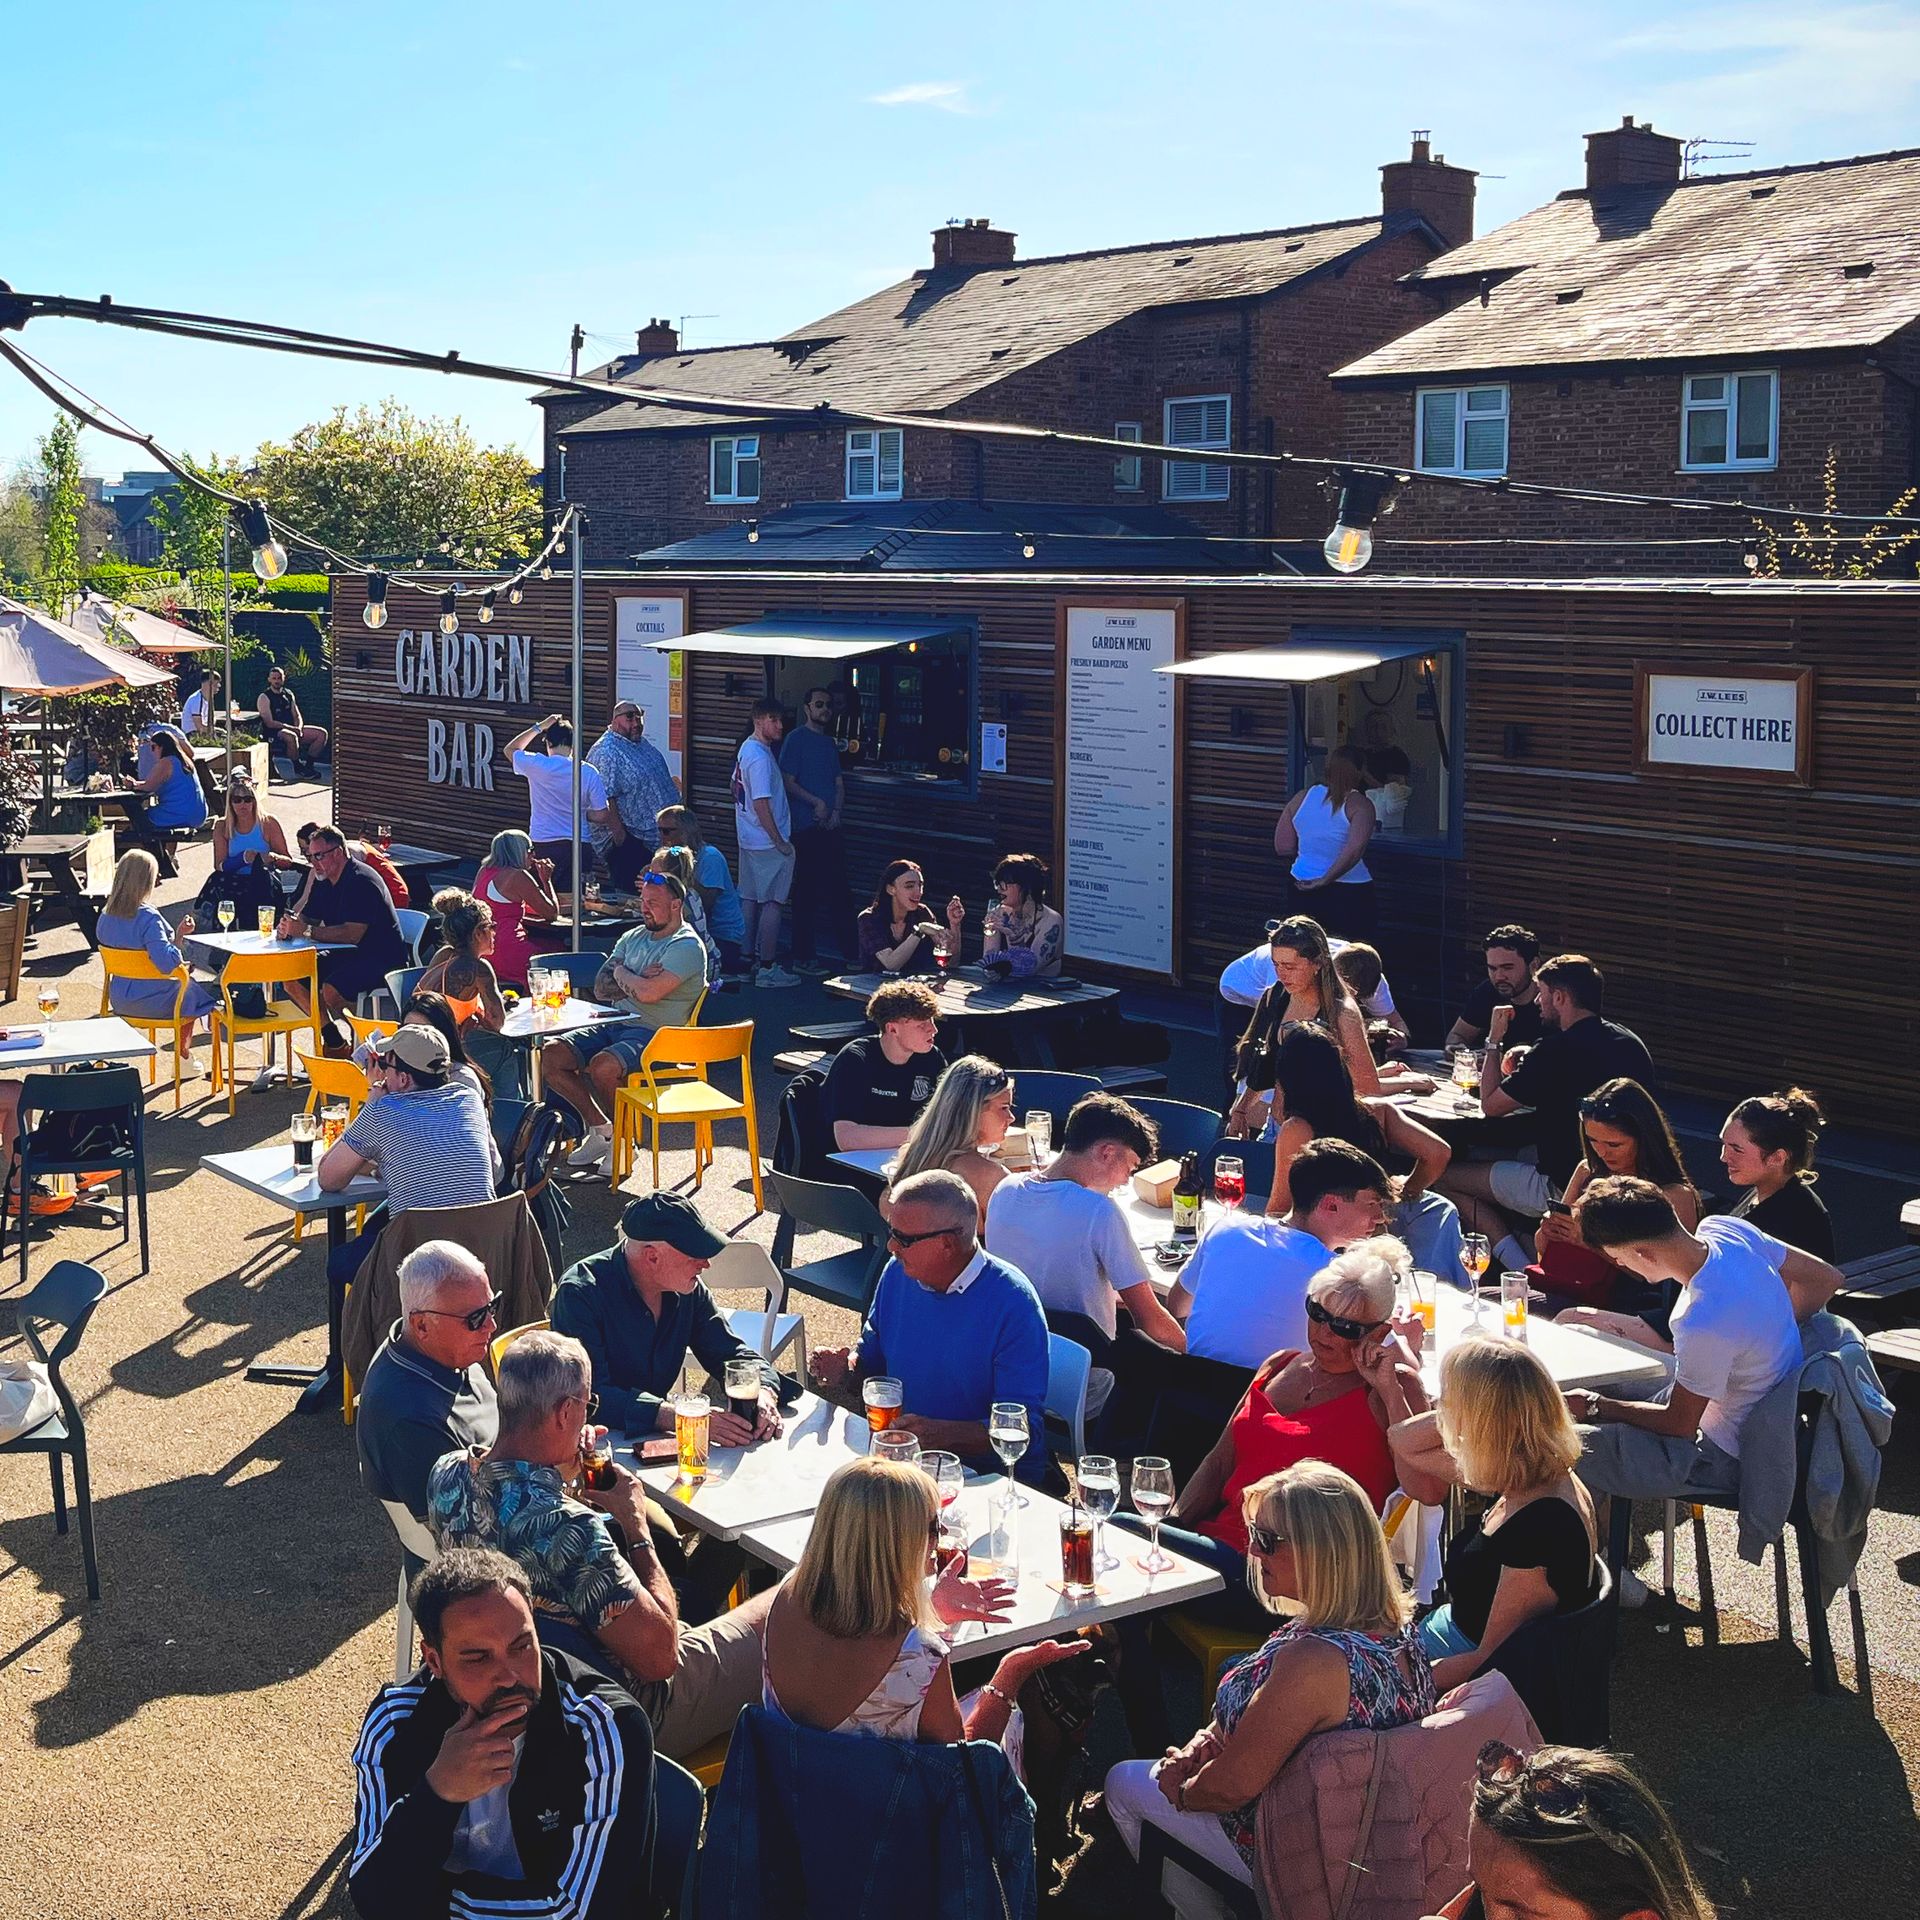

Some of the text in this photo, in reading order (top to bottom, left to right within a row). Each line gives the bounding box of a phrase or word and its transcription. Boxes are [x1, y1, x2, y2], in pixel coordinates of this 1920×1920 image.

[635, 622, 665, 633] COCKTAILS
[1092, 636, 1152, 651] GARDEN MENU
[395, 629, 534, 704] GARDEN
[1092, 659, 1110, 668] BAKED
[1110, 660, 1129, 669] PIZZAS
[1655, 713, 1792, 743] COLLECT HERE
[427, 718, 495, 791] BAR
[1069, 752, 1093, 762] BURGERS
